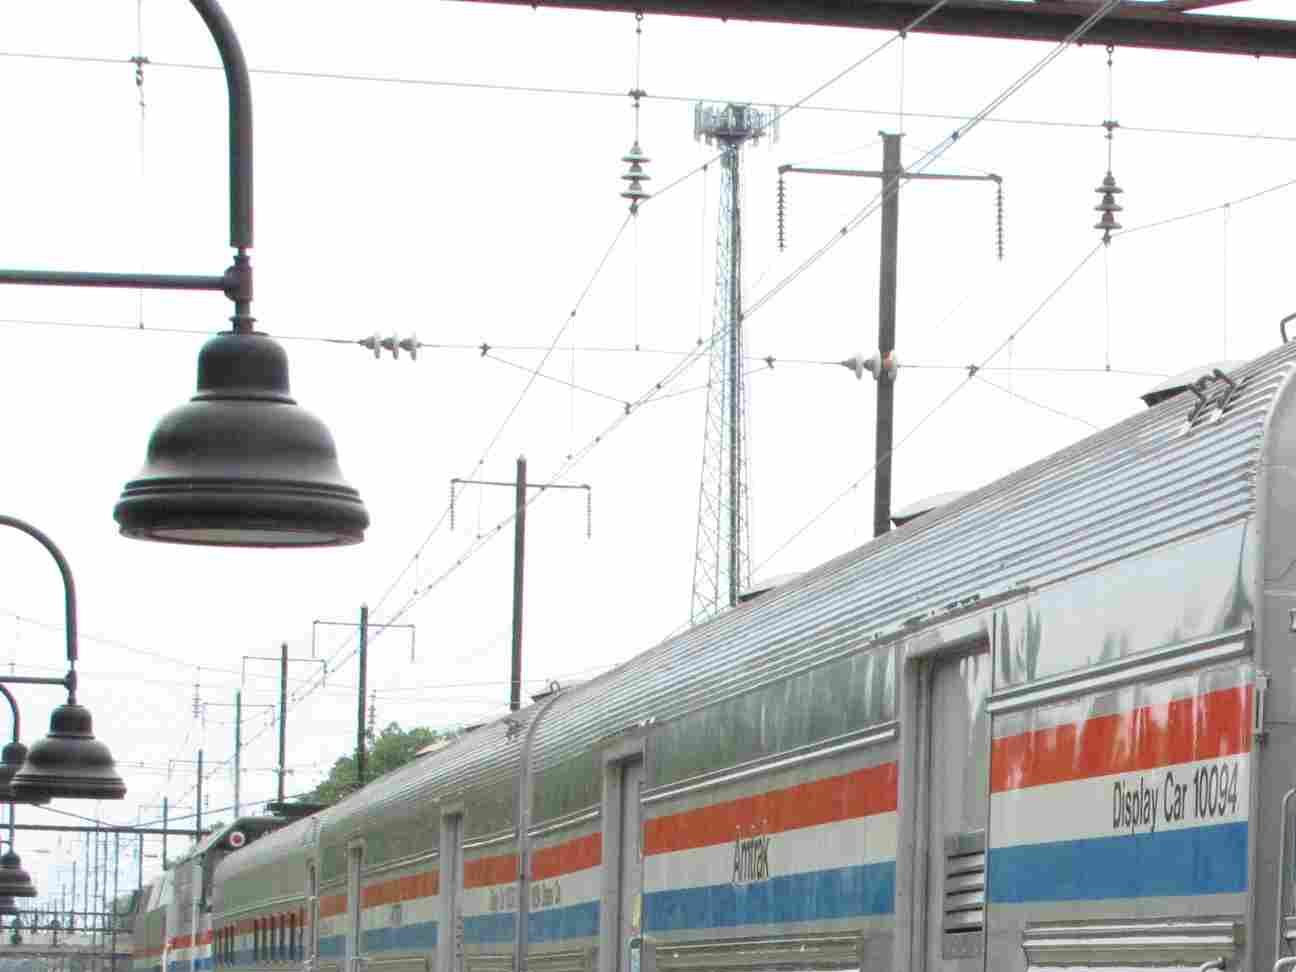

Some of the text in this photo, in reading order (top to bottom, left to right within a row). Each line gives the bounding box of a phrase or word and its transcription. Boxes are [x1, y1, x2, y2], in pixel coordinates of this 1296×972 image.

[1112, 761, 1238, 833] Display Car 10094
